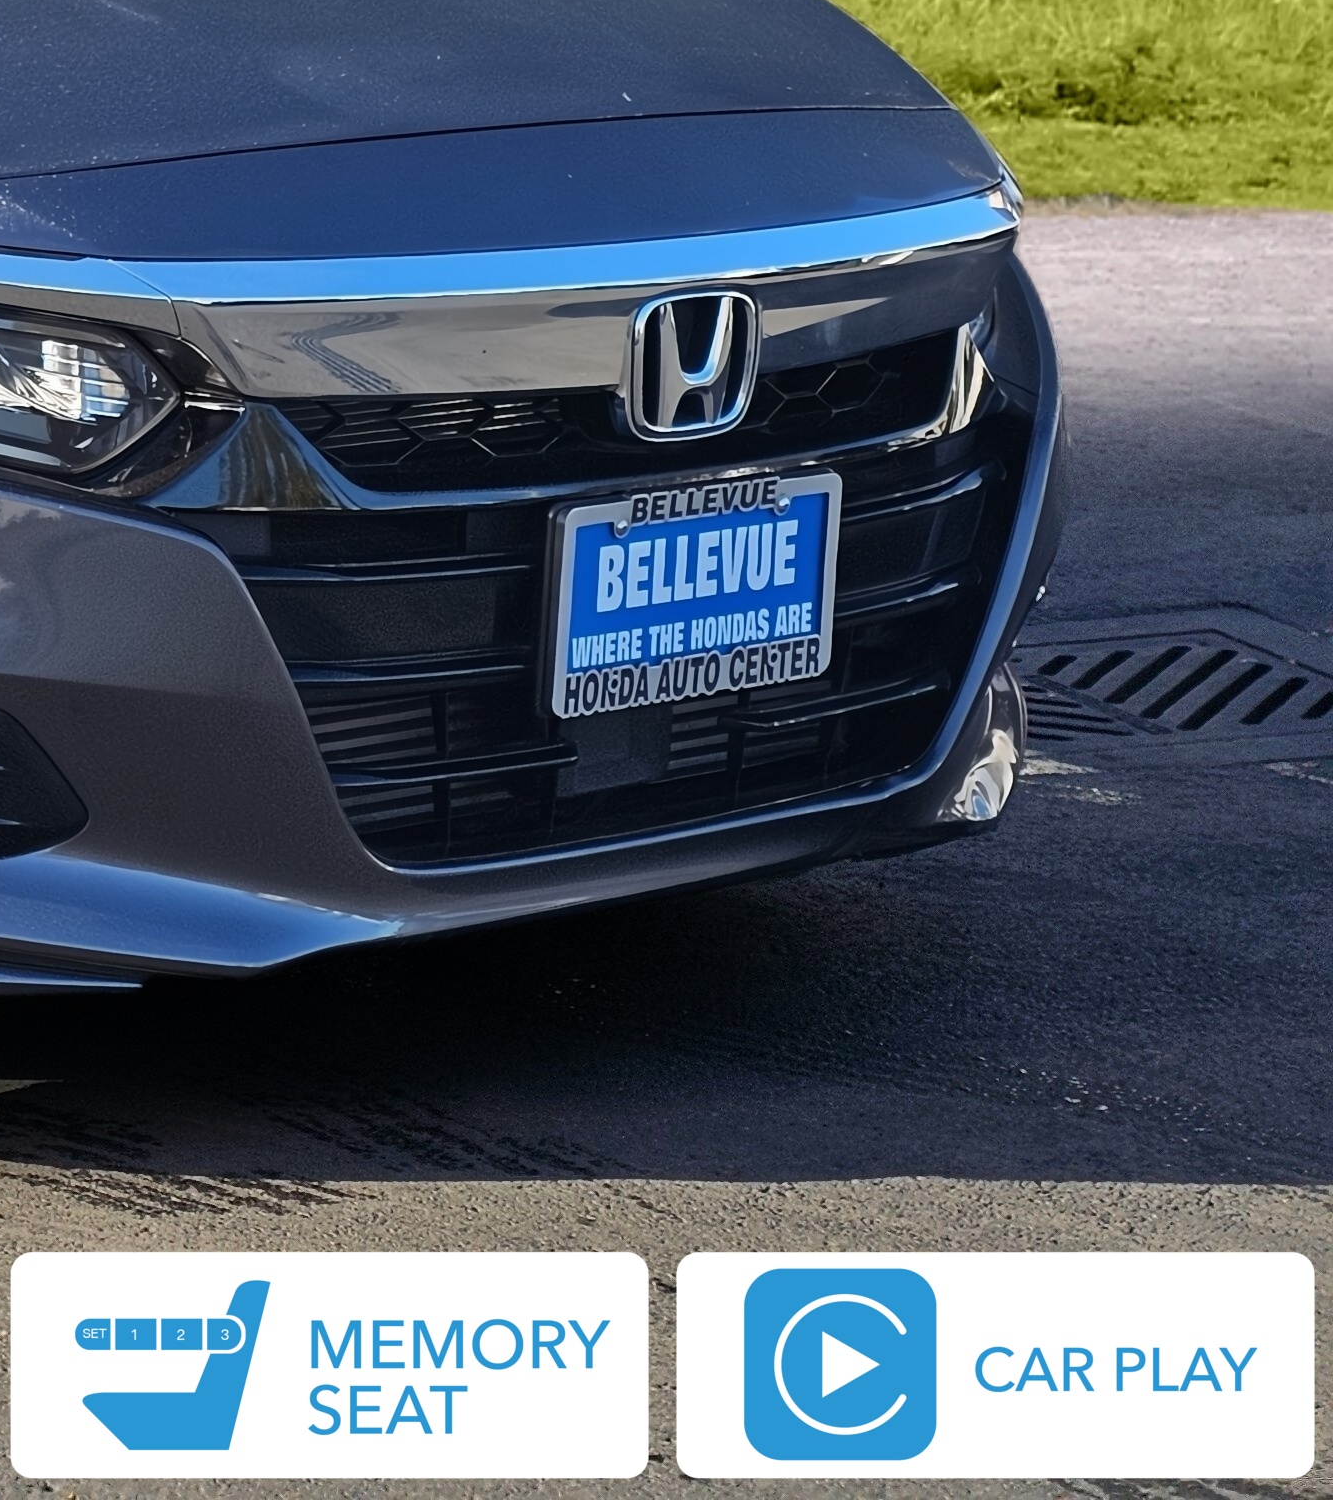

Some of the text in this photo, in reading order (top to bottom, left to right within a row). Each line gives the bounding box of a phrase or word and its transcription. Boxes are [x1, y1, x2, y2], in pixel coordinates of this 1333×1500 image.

[631, 479, 779, 524] BELLEVUE
[596, 519, 799, 613] BELLEVUE
[571, 601, 813, 669] WHERE THE HONDAS ARE
[564, 638, 821, 715] HONDA AUTO CENTER
